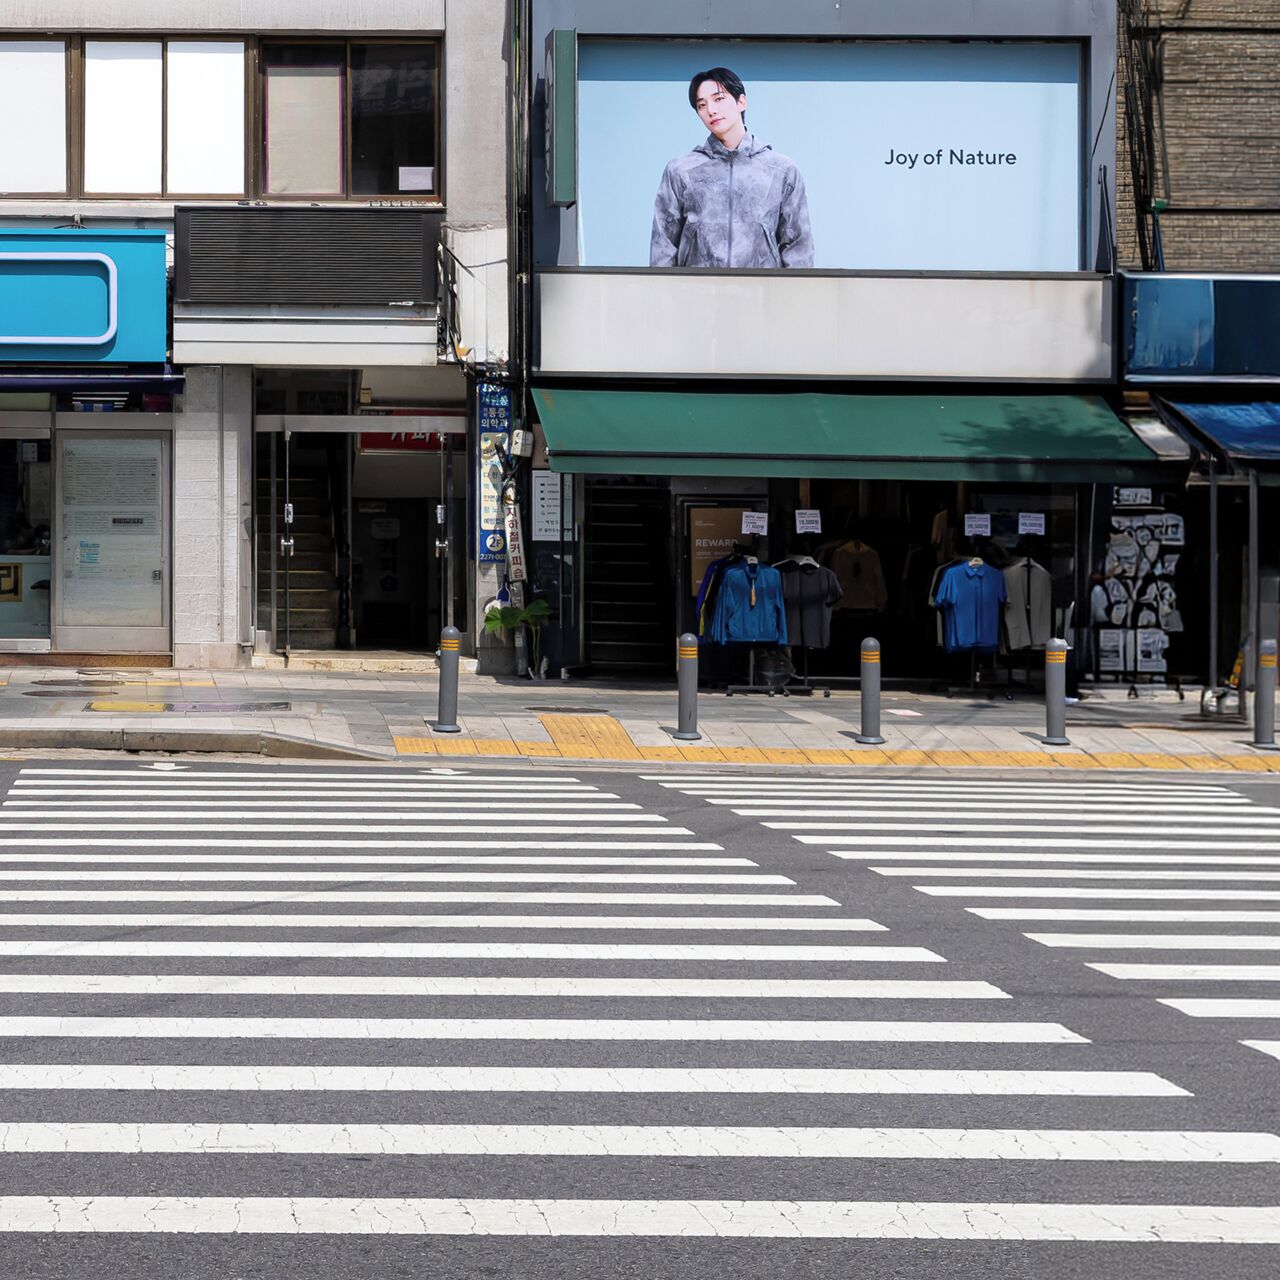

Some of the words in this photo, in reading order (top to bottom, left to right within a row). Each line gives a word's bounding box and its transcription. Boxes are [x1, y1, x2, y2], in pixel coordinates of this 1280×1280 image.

[884, 148, 919, 170] Joy
[923, 148, 943, 166] of
[949, 148, 1017, 166] Nature
